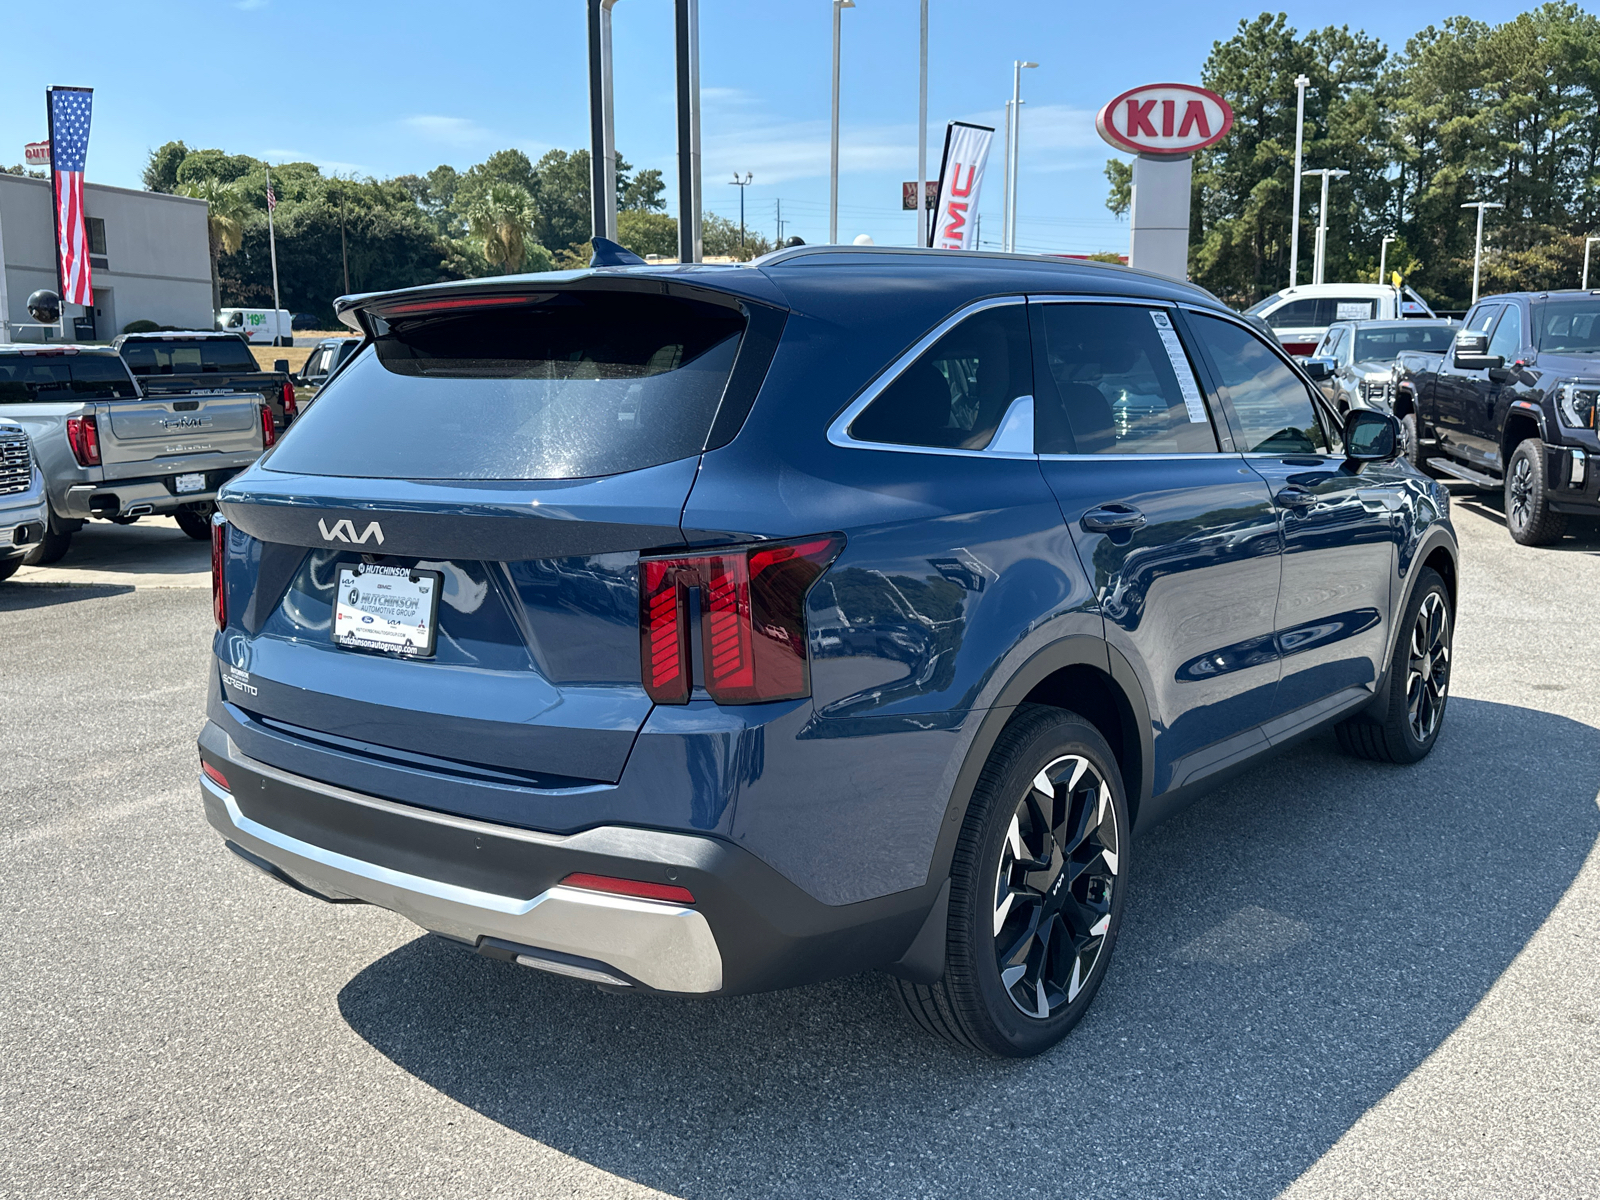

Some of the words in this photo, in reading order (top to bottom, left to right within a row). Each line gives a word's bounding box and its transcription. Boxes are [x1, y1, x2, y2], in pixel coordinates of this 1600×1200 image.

[1126, 99, 1211, 137] KIA
[943, 162, 976, 249] MC
[164, 417, 213, 430] GMC
[318, 518, 385, 545] KIA
[366, 564, 411, 577] HUTCHINSON
[360, 592, 419, 609] HUTCHINSON
[361, 604, 395, 615] AUTOMOTIVE
[396, 609, 416, 617] GROUP
[339, 634, 418, 655] Hutchinsonautogroup.com
